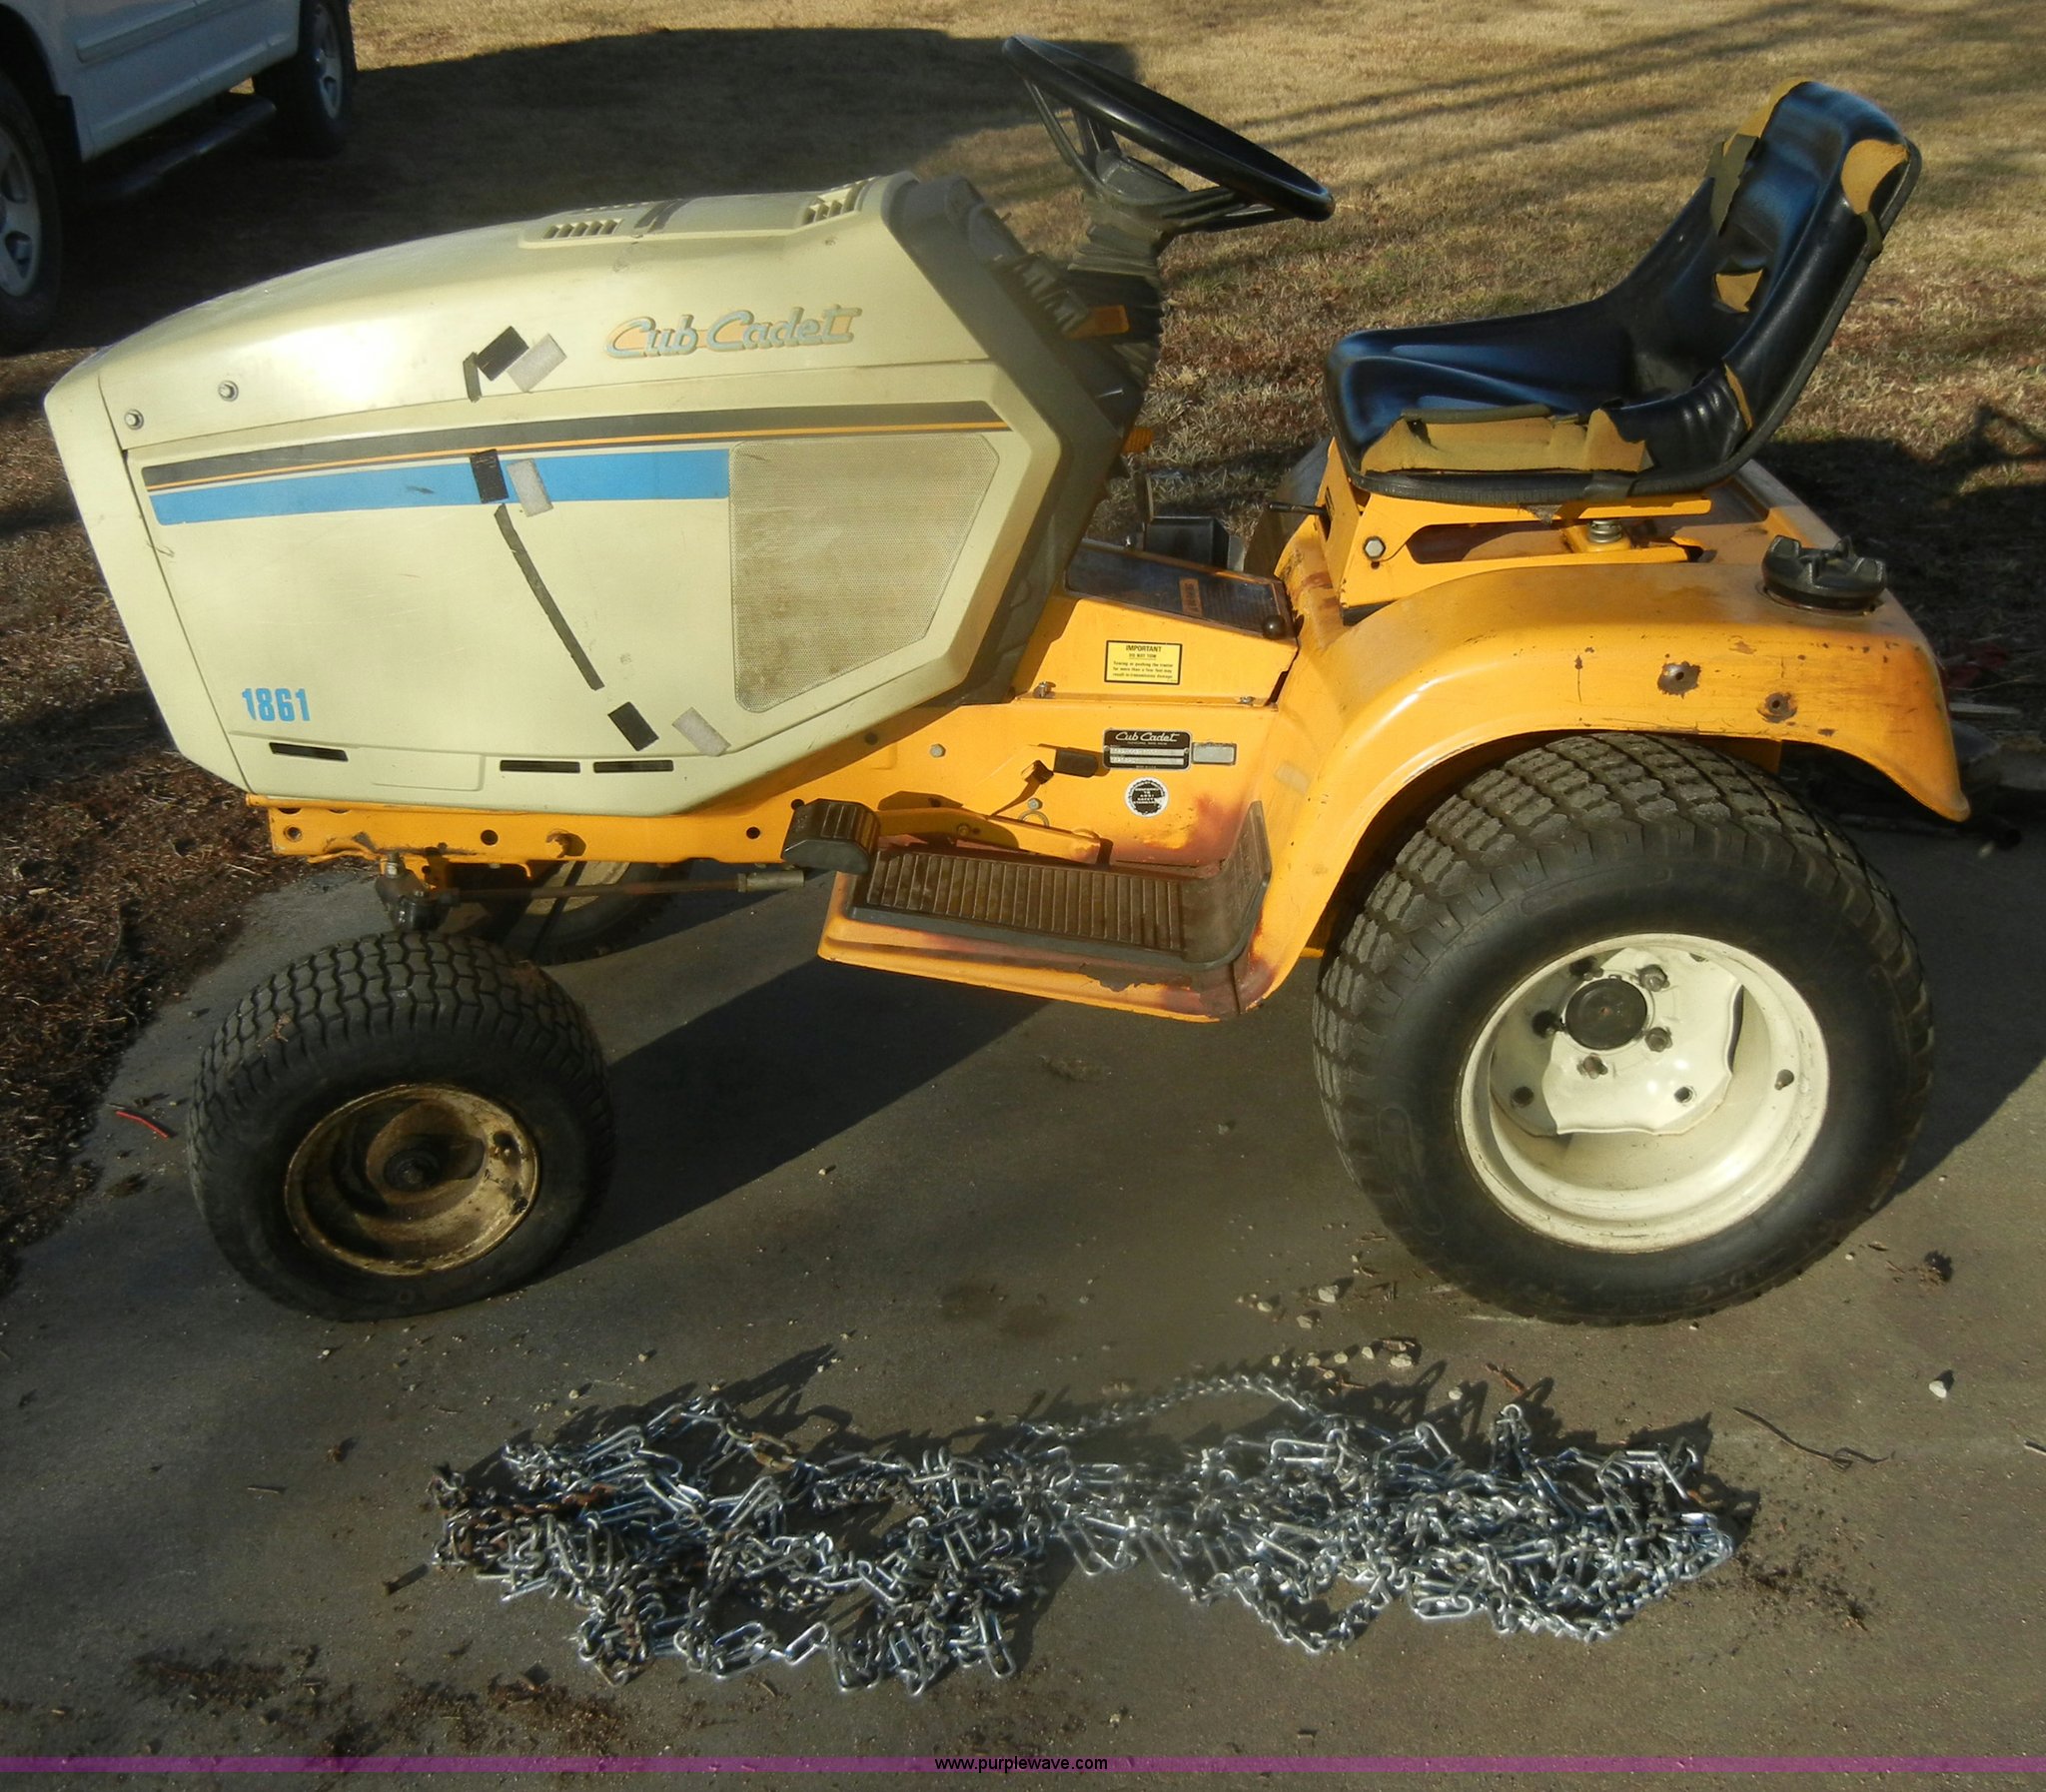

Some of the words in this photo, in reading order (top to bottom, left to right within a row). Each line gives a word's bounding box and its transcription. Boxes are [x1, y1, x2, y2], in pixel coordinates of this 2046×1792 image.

[604, 315, 698, 359] Cub
[706, 304, 863, 352] Cadet
[242, 688, 311, 721] 1861
[1115, 731, 1139, 741] Cub
[1140, 732, 1180, 742] Cadet
